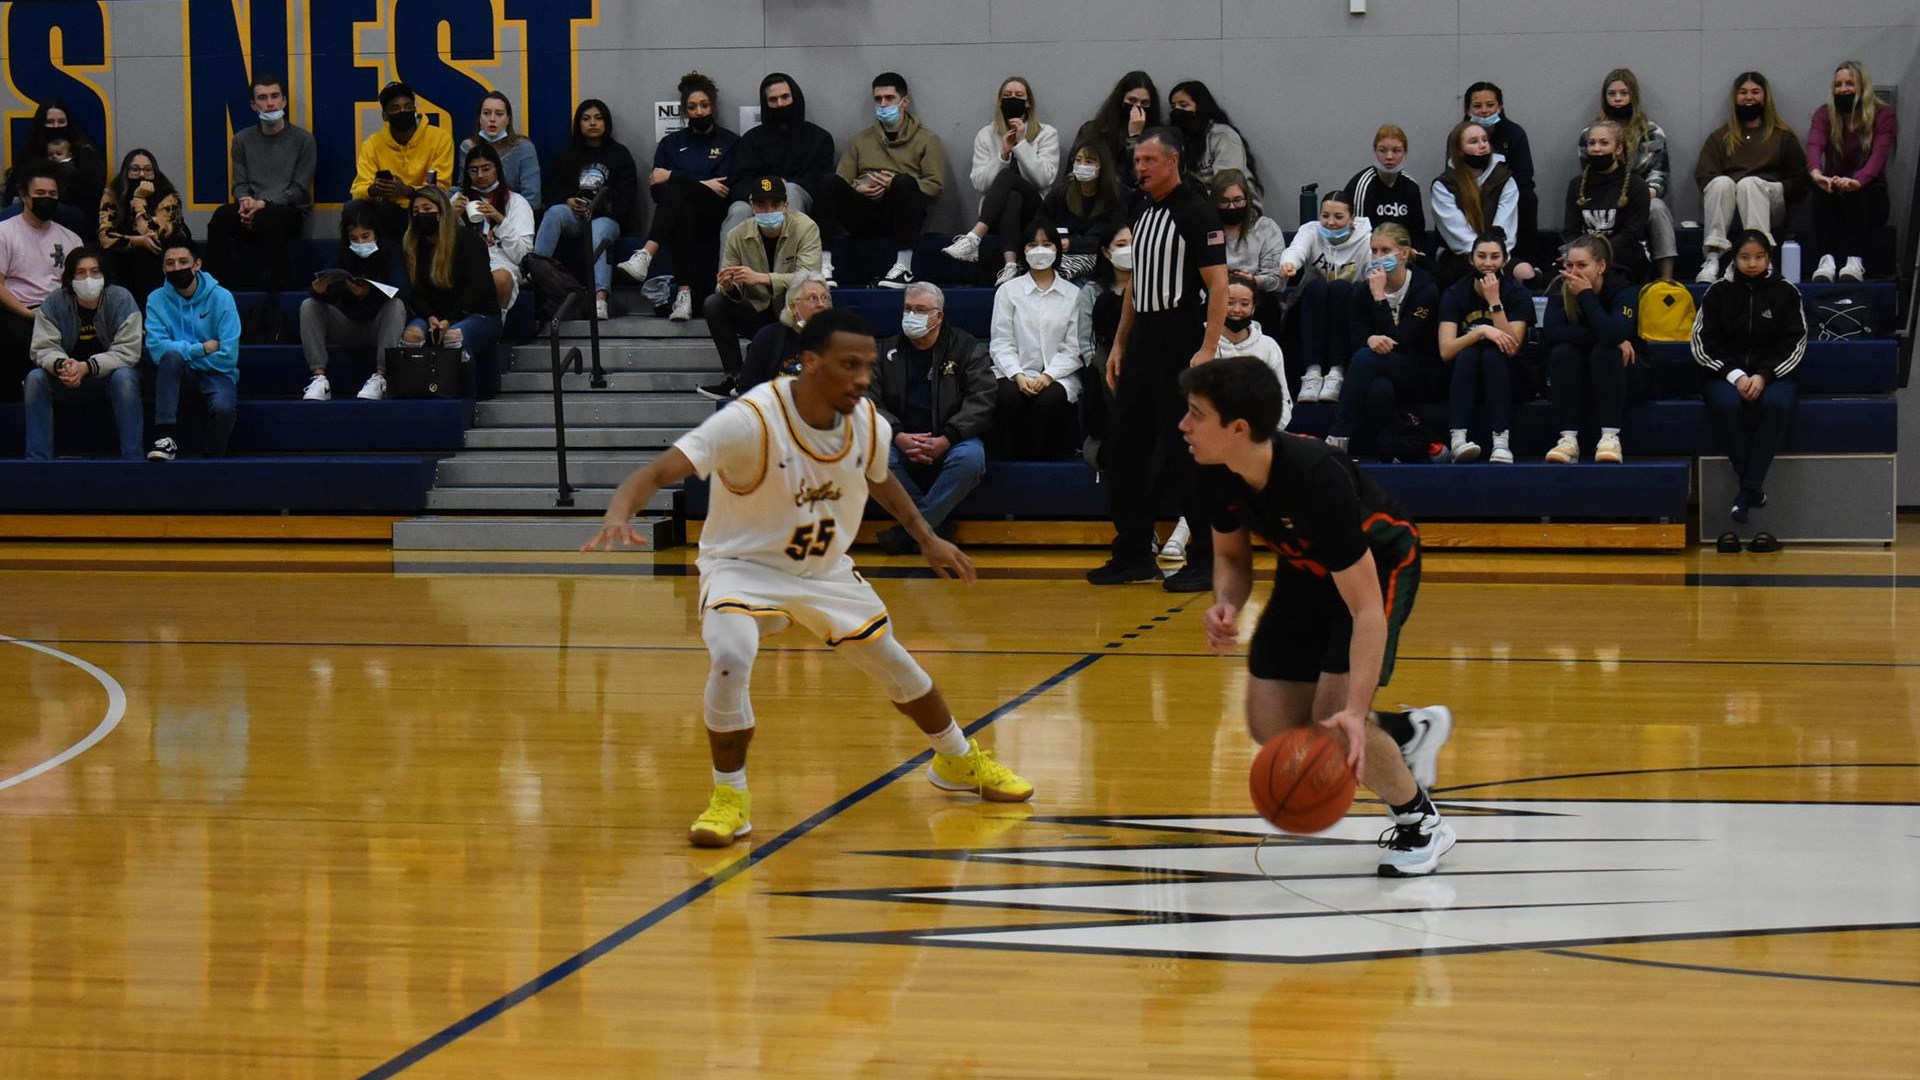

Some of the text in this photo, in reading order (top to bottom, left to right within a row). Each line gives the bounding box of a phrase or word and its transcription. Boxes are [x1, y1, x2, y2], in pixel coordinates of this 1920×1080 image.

[182, 0, 599, 210] NEST
[658, 105, 682, 117] NU
[1581, 208, 1617, 230] NU
[1412, 305, 1430, 320] 25
[1622, 305, 1633, 318] 10
[785, 518, 835, 560] 55
